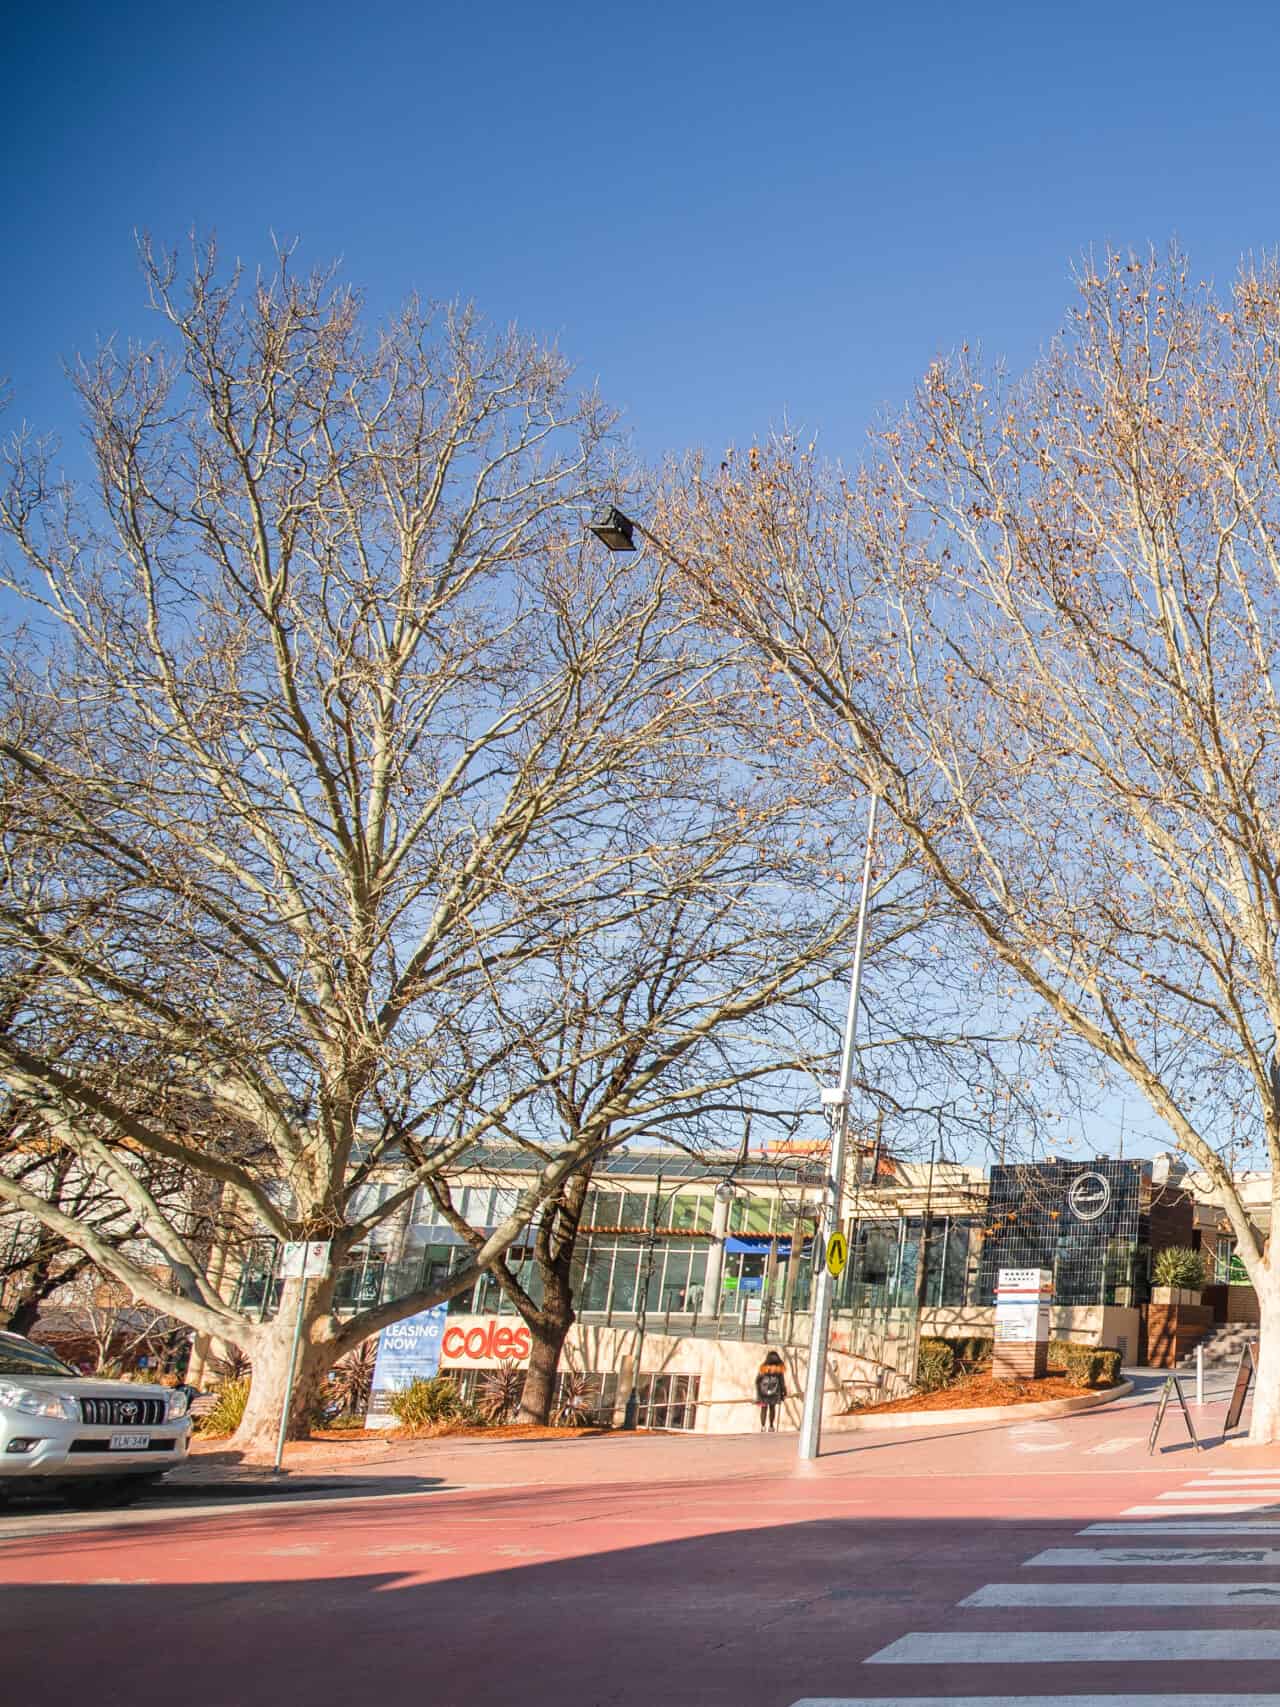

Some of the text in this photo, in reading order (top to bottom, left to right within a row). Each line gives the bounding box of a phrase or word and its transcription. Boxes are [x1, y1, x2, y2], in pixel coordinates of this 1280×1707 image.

[385, 1325, 439, 1337] LEASING
[383, 1338, 418, 1350] NOW
[441, 1321, 531, 1360] coles
